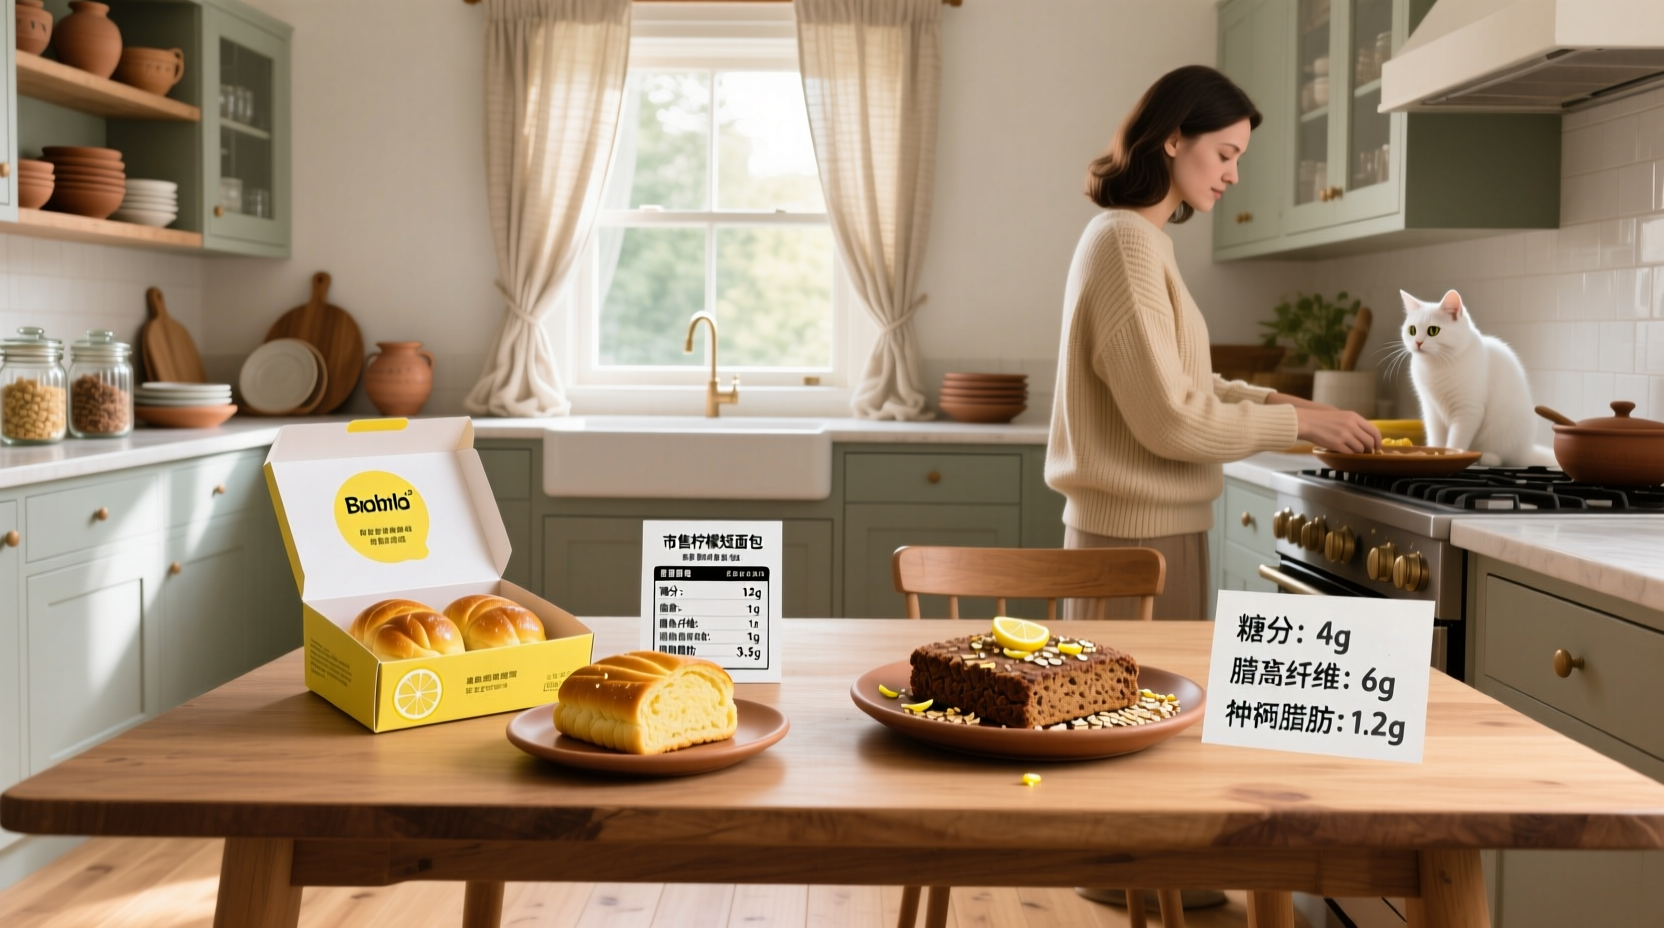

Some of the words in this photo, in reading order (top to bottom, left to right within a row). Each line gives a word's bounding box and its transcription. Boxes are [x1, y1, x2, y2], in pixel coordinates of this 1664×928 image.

[743, 587, 762, 600] 12g
[1316, 621, 1351, 655] 4g
[1361, 667, 1396, 702] 6g
[1351, 710, 1406, 746] 1.2g
